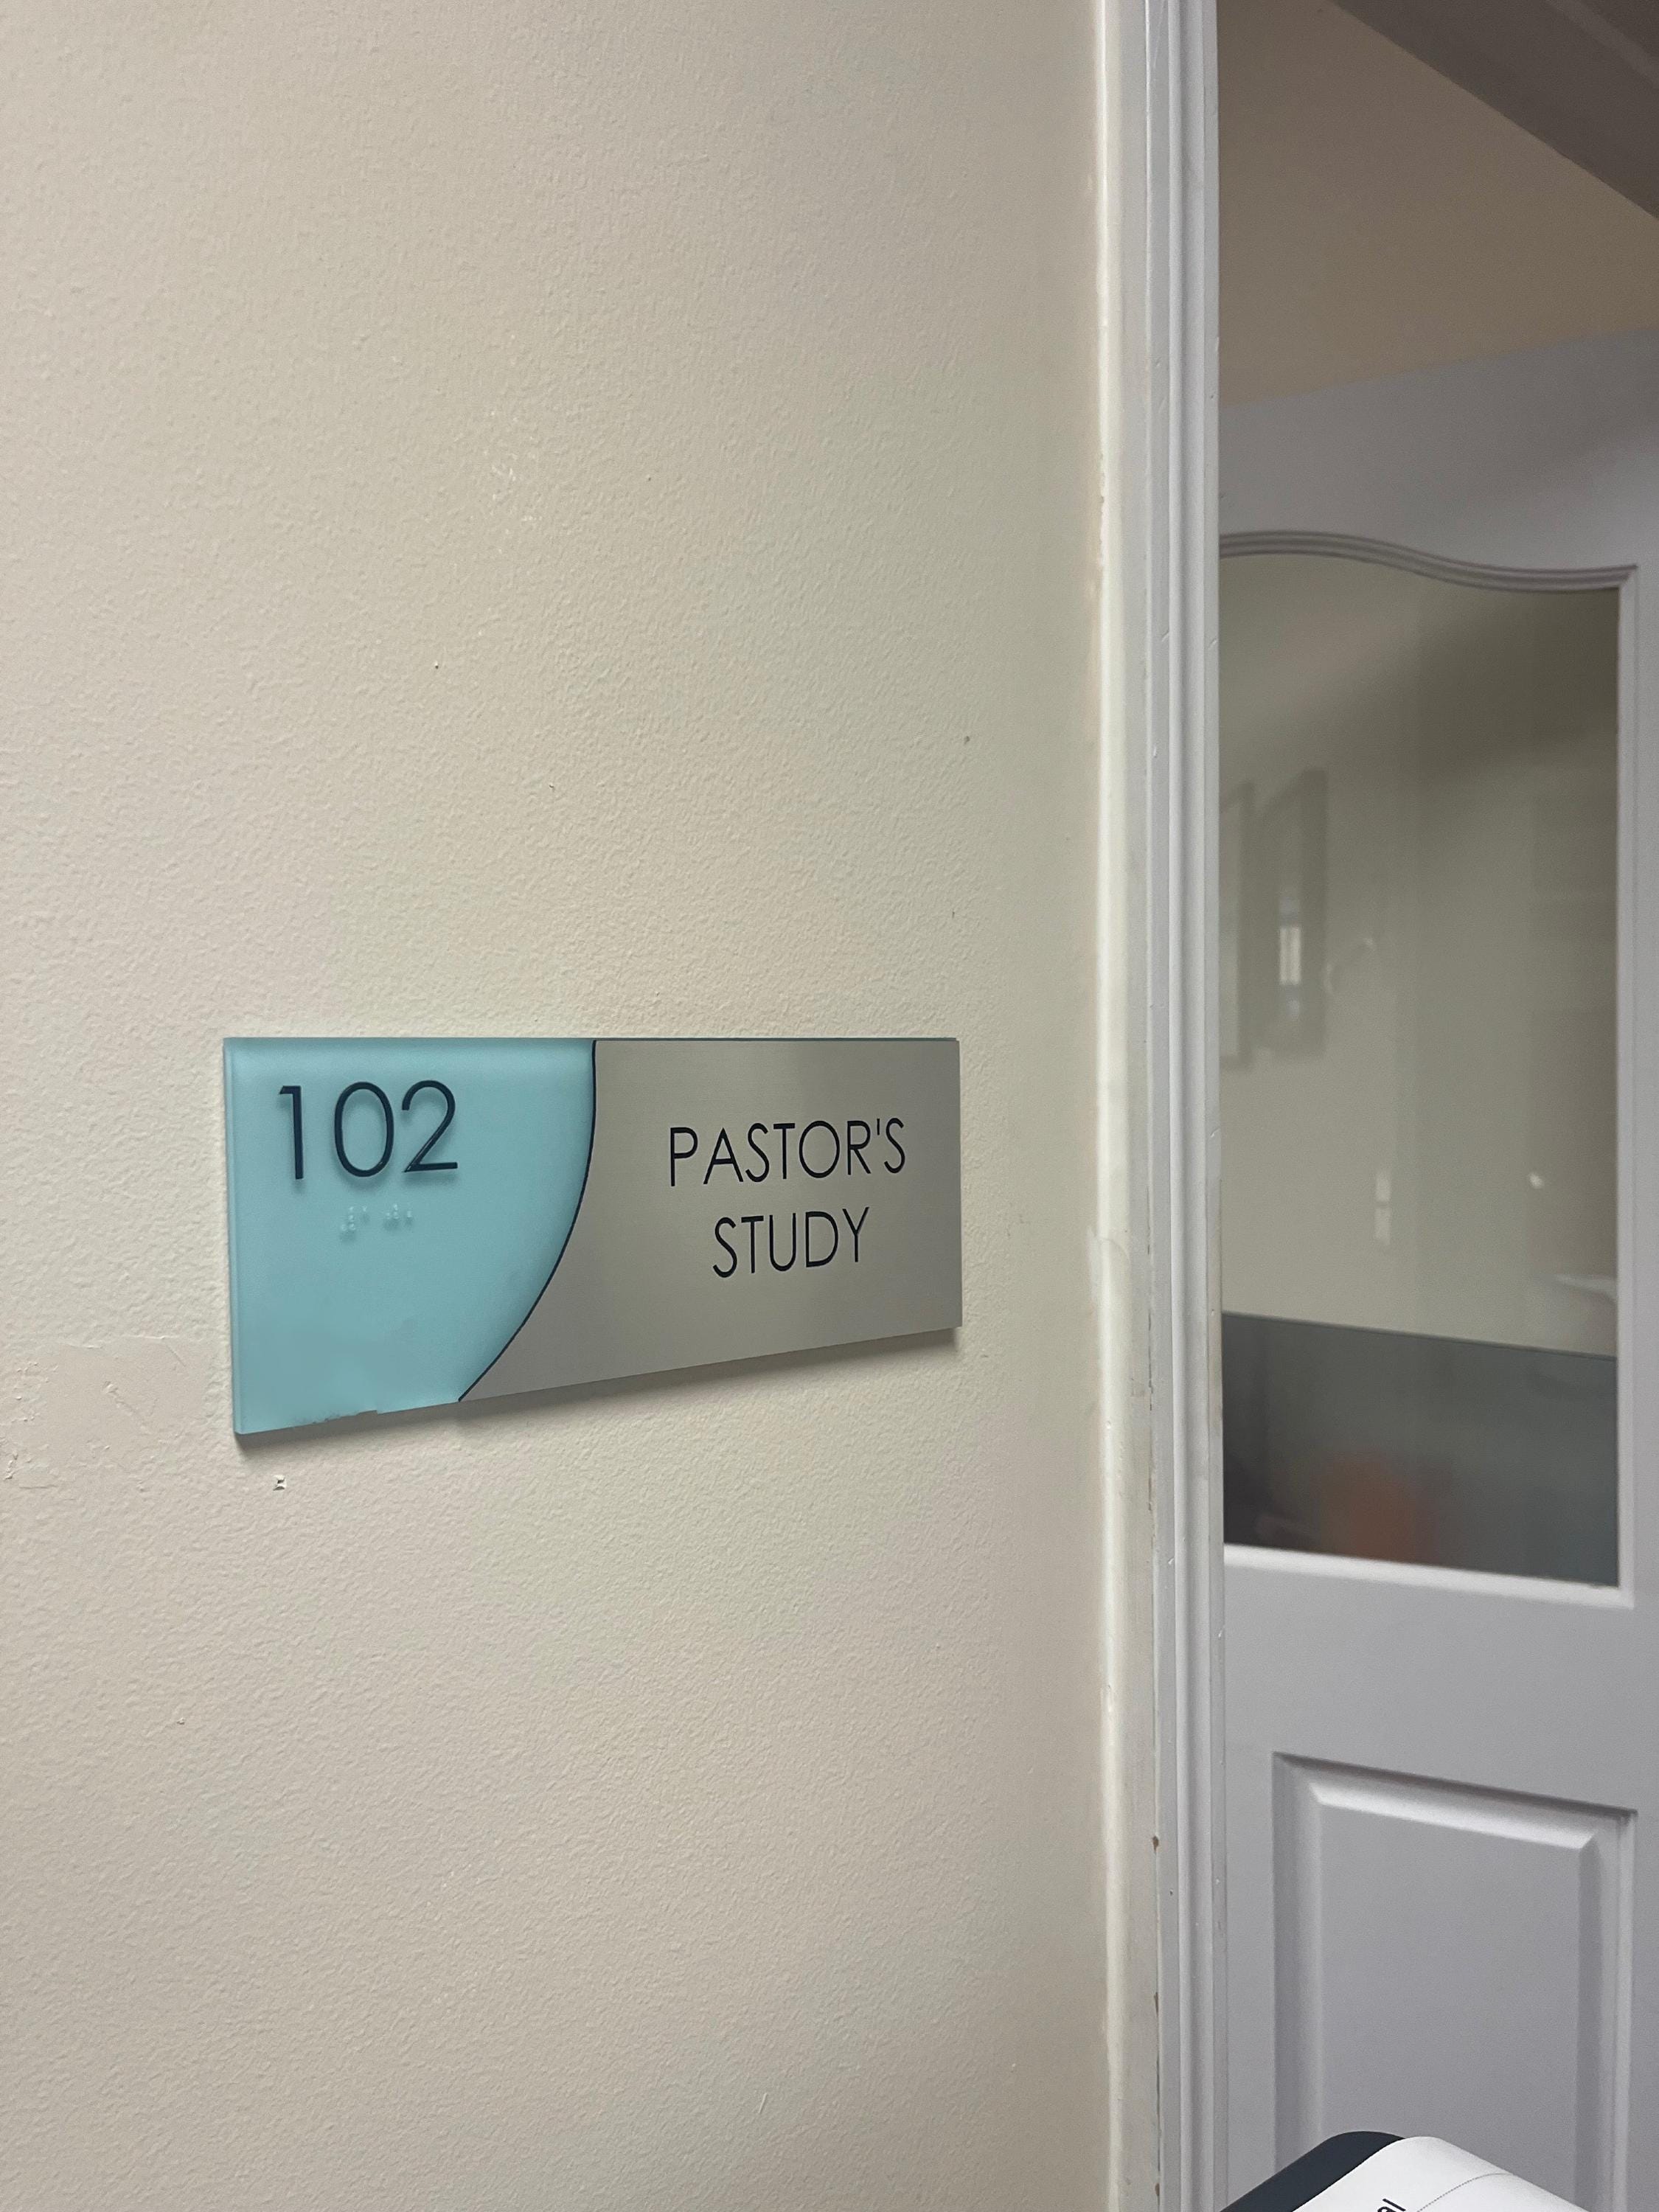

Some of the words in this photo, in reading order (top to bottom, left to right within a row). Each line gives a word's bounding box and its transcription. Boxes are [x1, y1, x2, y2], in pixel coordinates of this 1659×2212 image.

[278, 1079, 459, 1180] 102
[669, 1117, 906, 1187] PASTOR'S
[712, 1206, 870, 1279] STUDY
